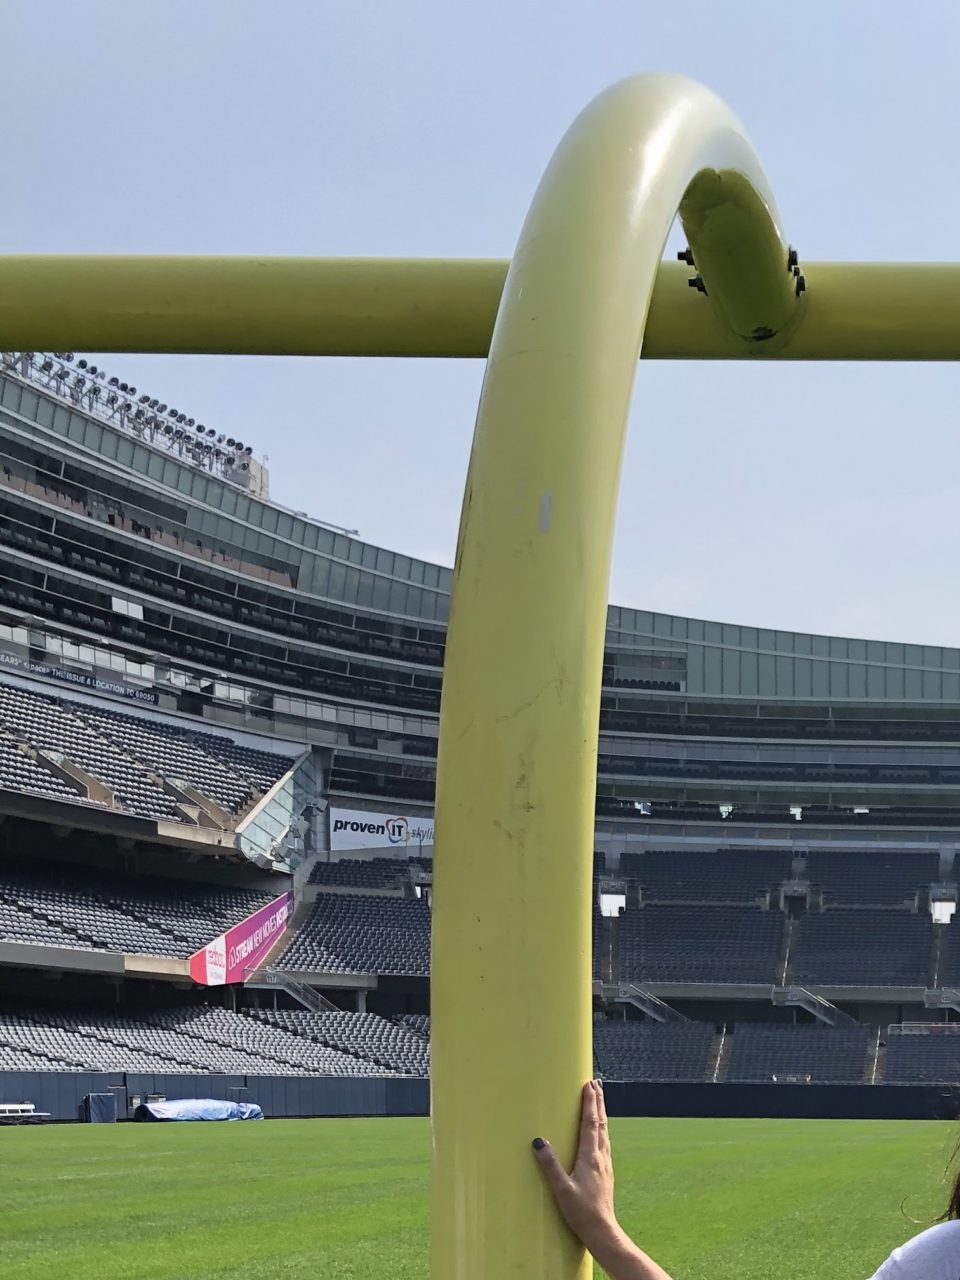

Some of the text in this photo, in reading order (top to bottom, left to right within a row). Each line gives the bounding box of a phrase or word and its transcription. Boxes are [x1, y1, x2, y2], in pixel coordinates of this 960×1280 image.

[66, 672, 86, 683] ISSUE
[92, 678, 125, 694] LOCATION
[333, 819, 434, 841] proven IT skyli
